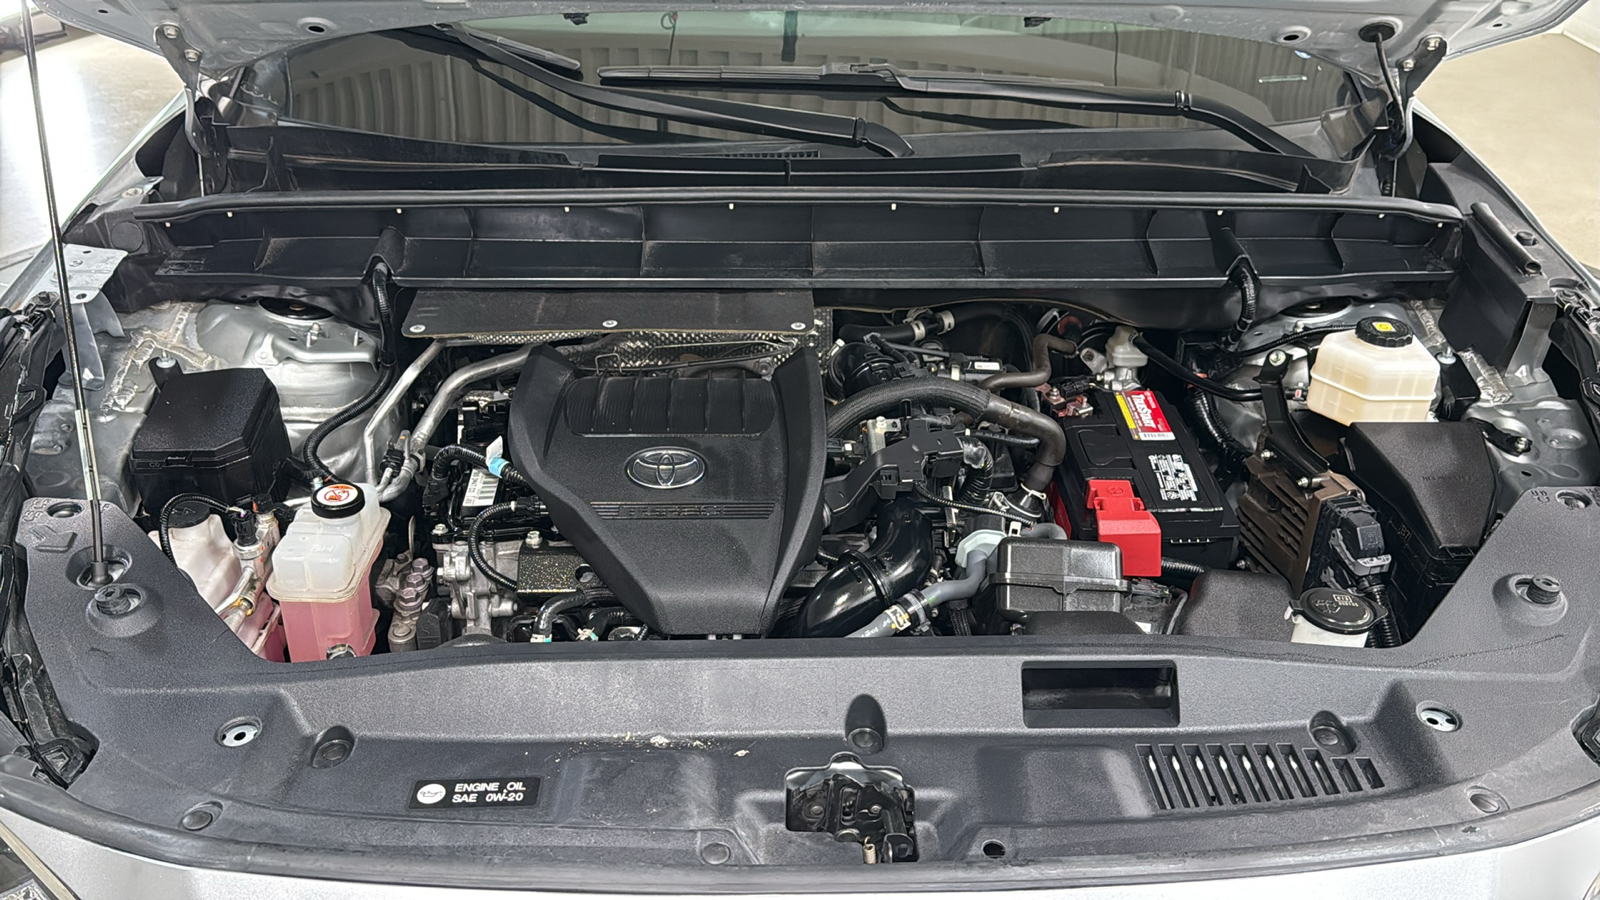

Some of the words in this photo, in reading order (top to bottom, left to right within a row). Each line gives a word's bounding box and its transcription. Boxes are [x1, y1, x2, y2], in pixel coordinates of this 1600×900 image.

[454, 782, 500, 793] ENGINE
[506, 781, 527, 791] OIL
[452, 793, 478, 803] SAE
[485, 792, 524, 802] 0W-20
